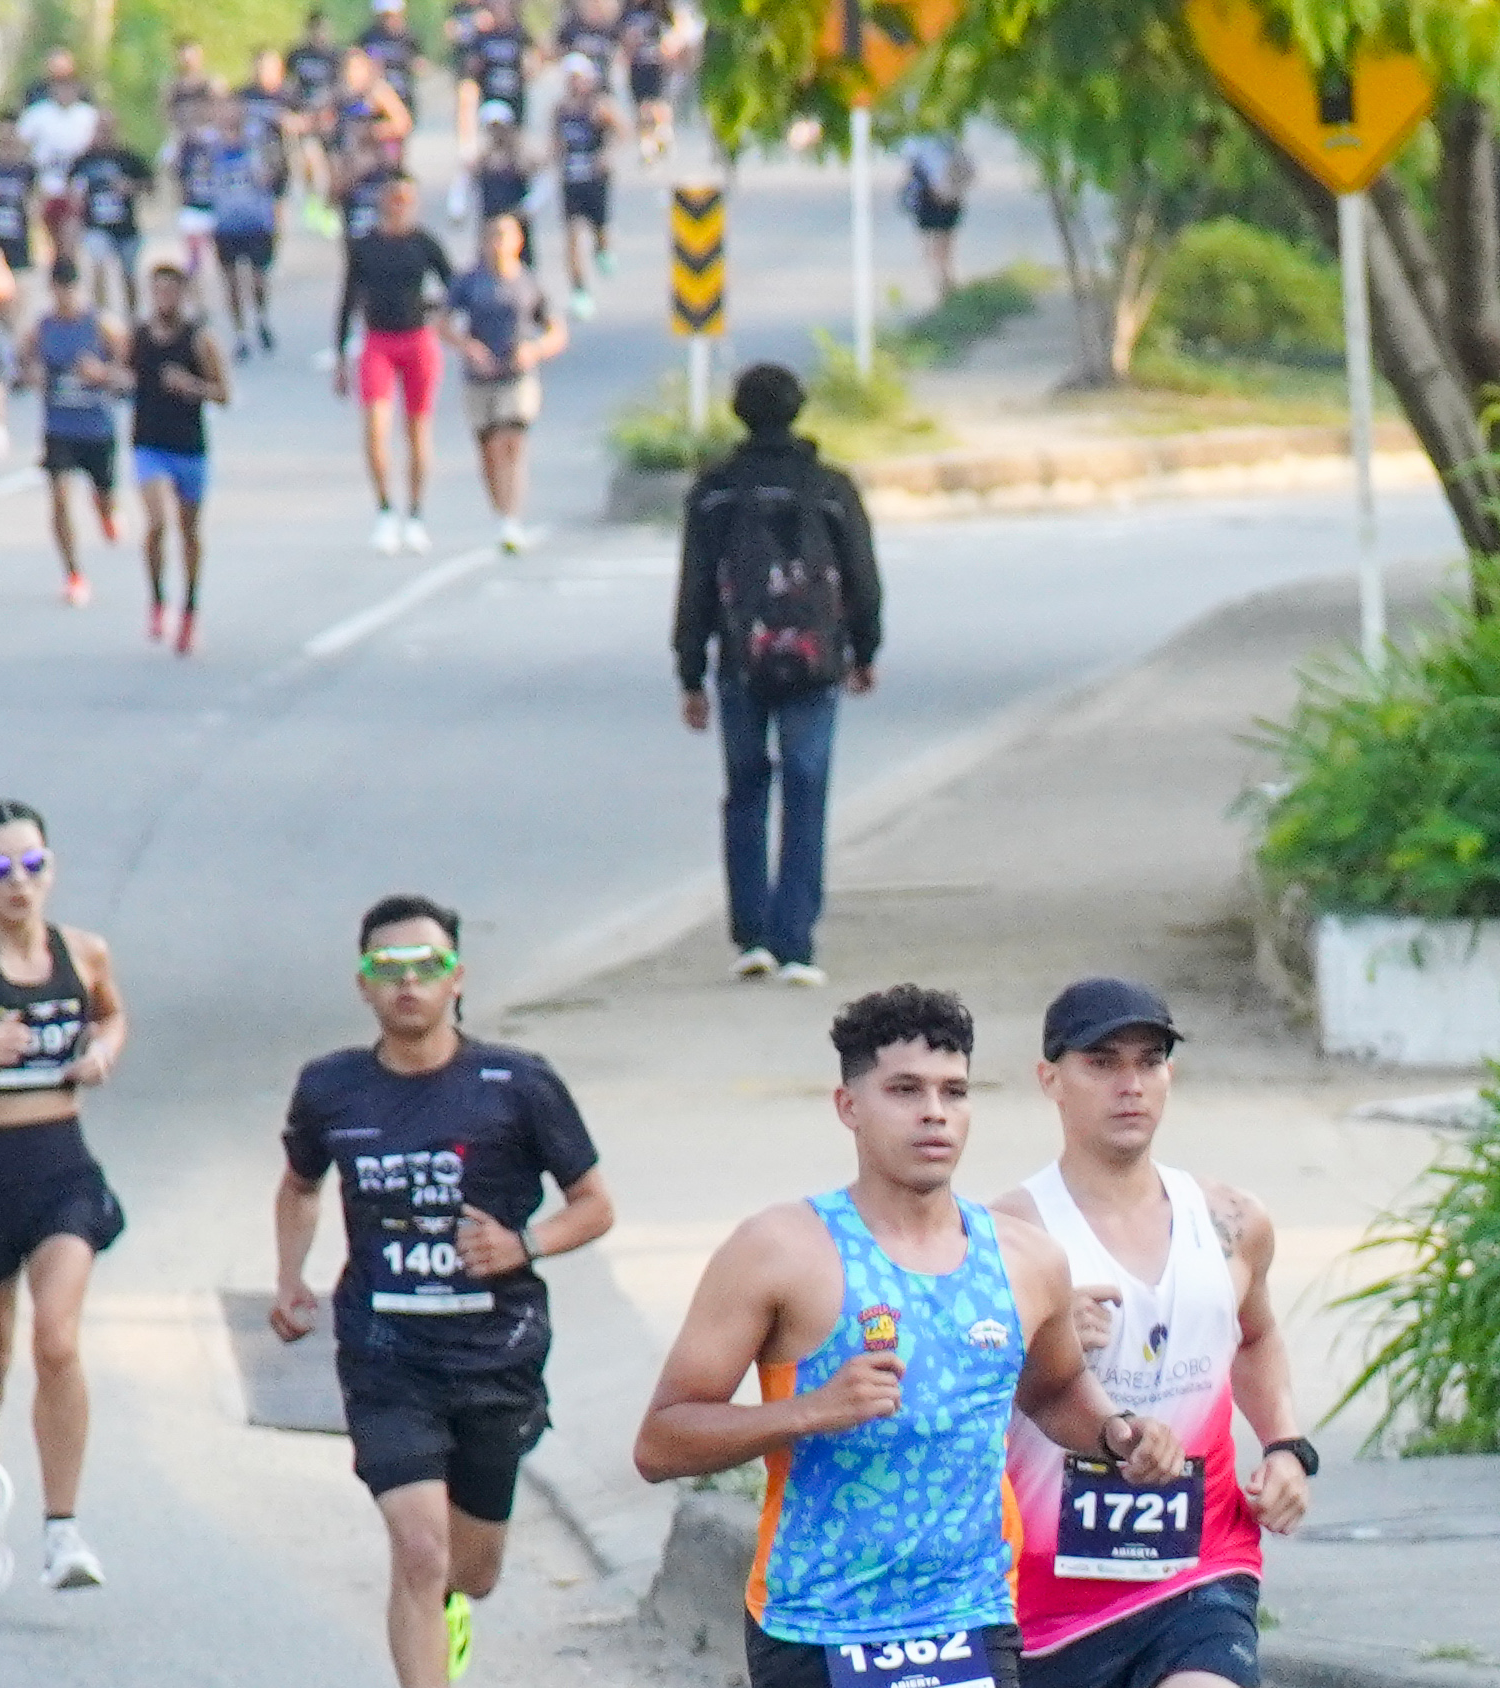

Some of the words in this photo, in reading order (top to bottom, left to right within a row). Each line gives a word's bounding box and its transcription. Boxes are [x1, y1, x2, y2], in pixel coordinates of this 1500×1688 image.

[383, 1241, 466, 1278] 140
[1073, 1490, 1189, 1534] 1721
[840, 1630, 972, 1673] 1362
